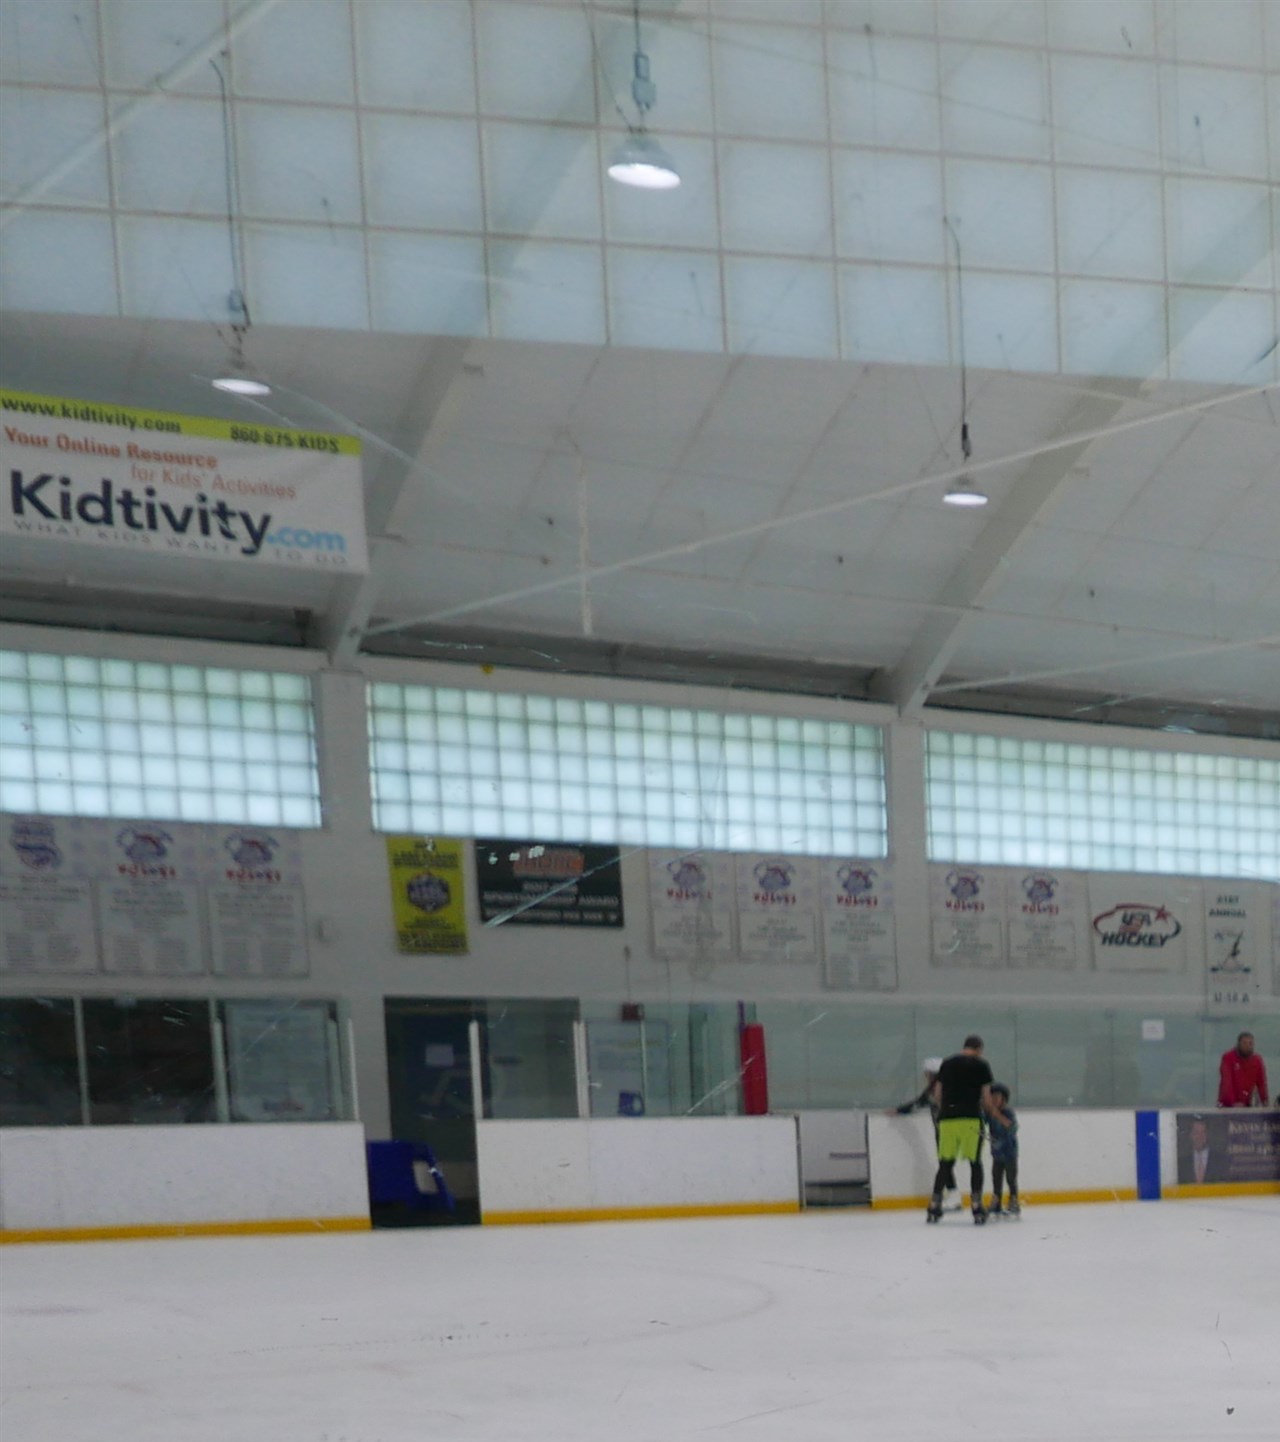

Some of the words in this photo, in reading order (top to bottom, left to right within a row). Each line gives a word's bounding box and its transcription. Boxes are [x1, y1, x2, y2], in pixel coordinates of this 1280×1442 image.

[1, 398, 182, 432] www.kidtivity.com
[4, 425, 48, 448] Your
[57, 433, 121, 458] Online
[126, 441, 217, 468] Resource
[131, 463, 155, 481] for
[212, 474, 296, 499] Activities
[13, 520, 80, 537] WHAT
[98, 530, 151, 543] KIDS
[1102, 933, 1168, 946] HOCKEY
